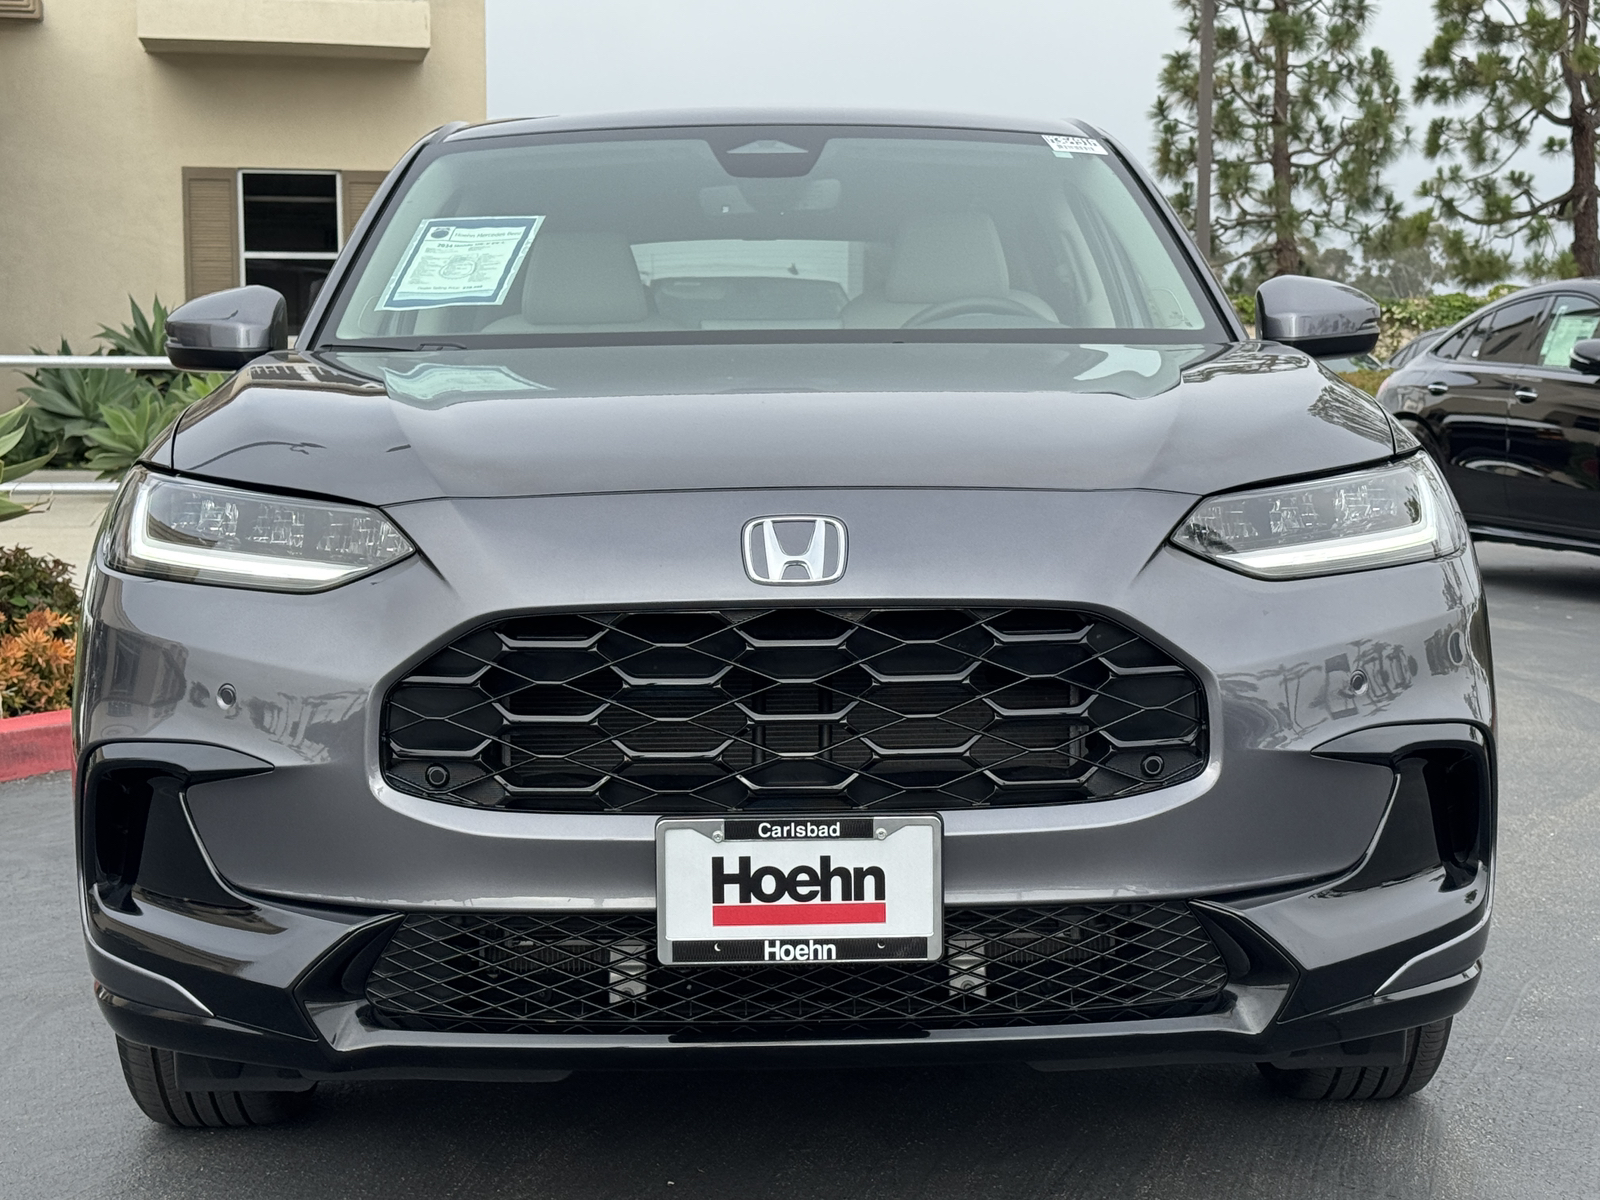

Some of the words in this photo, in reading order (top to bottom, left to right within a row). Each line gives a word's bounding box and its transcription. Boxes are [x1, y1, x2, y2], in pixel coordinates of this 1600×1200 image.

[757, 821, 841, 838] Carlsbad
[711, 855, 886, 904] Hoehn
[763, 940, 837, 961] Hoehn
